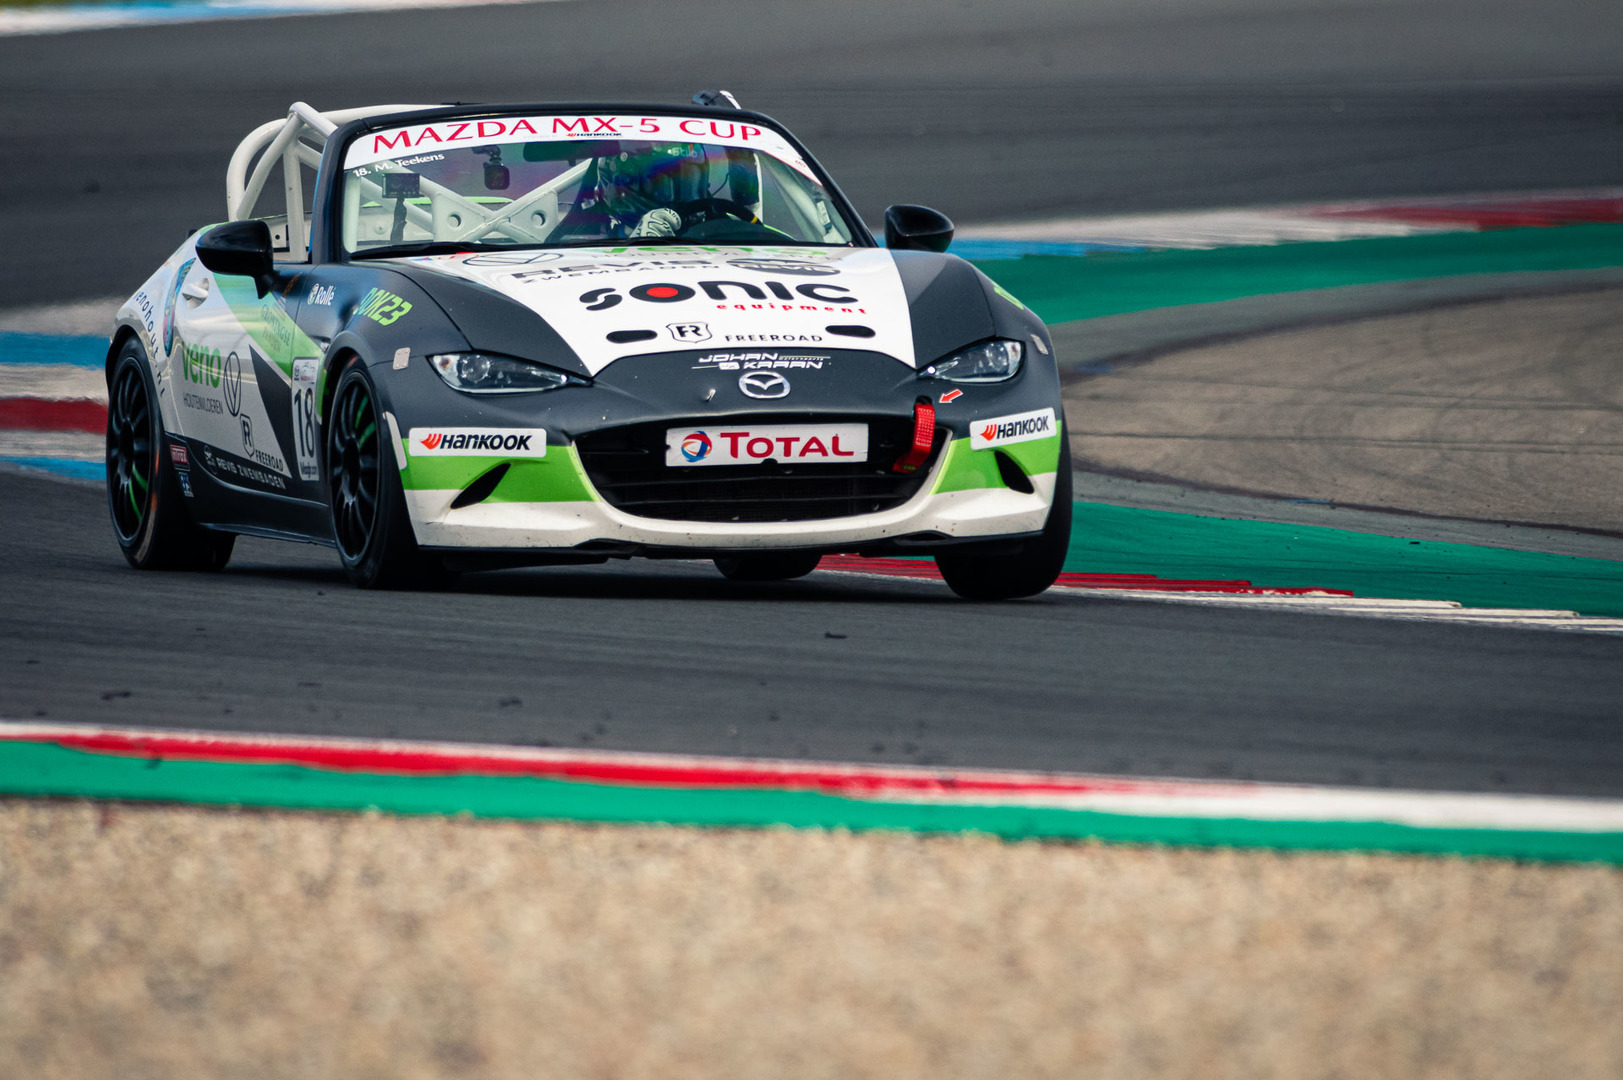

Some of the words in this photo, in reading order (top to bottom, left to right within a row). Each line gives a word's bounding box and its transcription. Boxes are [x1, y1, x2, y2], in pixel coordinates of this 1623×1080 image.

[373, 119, 538, 154] MAZDA
[552, 117, 661, 134] MX-5
[679, 119, 762, 141] CUP
[374, 162, 393, 173] M.
[395, 153, 445, 168] Teekens
[716, 302, 867, 315] equipment
[724, 333, 824, 343] FREEROAD
[181, 340, 222, 389] veno
[698, 352, 779, 363] JOHAN
[294, 387, 315, 459] 18
[719, 431, 855, 459] TOTAL
[255, 449, 284, 472] FREEROAD
